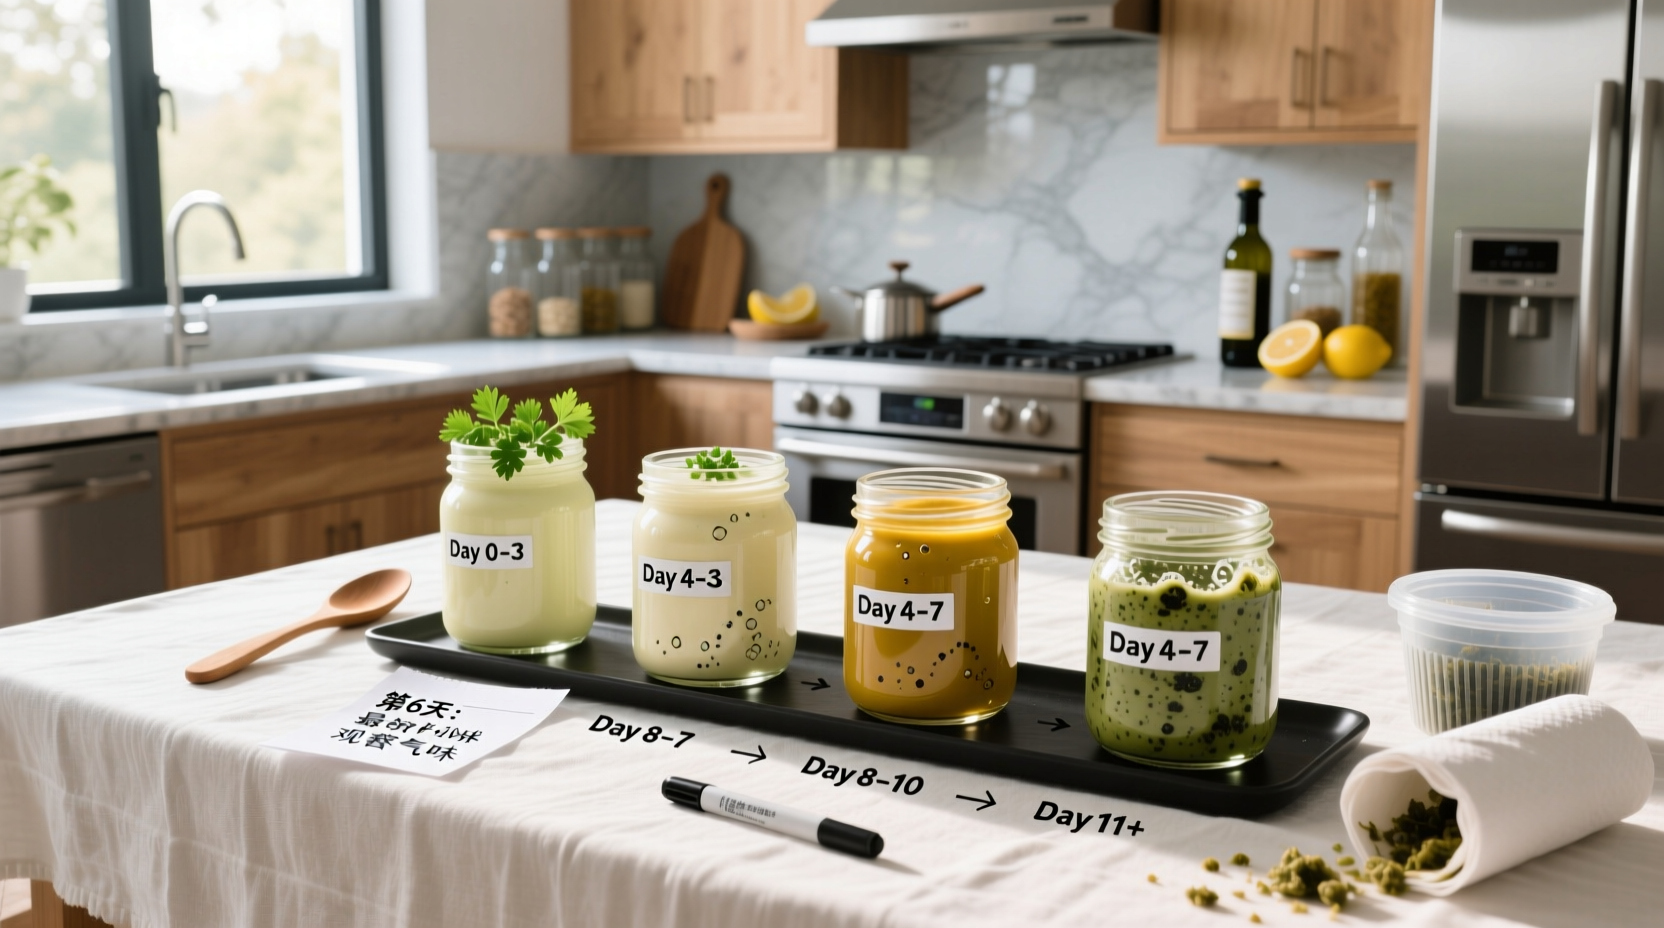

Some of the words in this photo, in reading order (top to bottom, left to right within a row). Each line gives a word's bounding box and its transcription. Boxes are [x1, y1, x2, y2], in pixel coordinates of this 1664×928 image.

[449, 538, 481, 566] Day
[485, 542, 524, 562] 0–3
[642, 563, 678, 592] Day
[680, 568, 723, 589] 4–3
[857, 594, 897, 625] Day
[899, 600, 945, 622] 4–7
[1109, 630, 1155, 664] Day
[1158, 639, 1209, 662] 4–7
[588, 714, 642, 743] Day
[800, 755, 858, 787] Day
[856, 767, 925, 796] 8–10
[1033, 800, 1094, 834] Day
[1097, 812, 1146, 837] 11+
